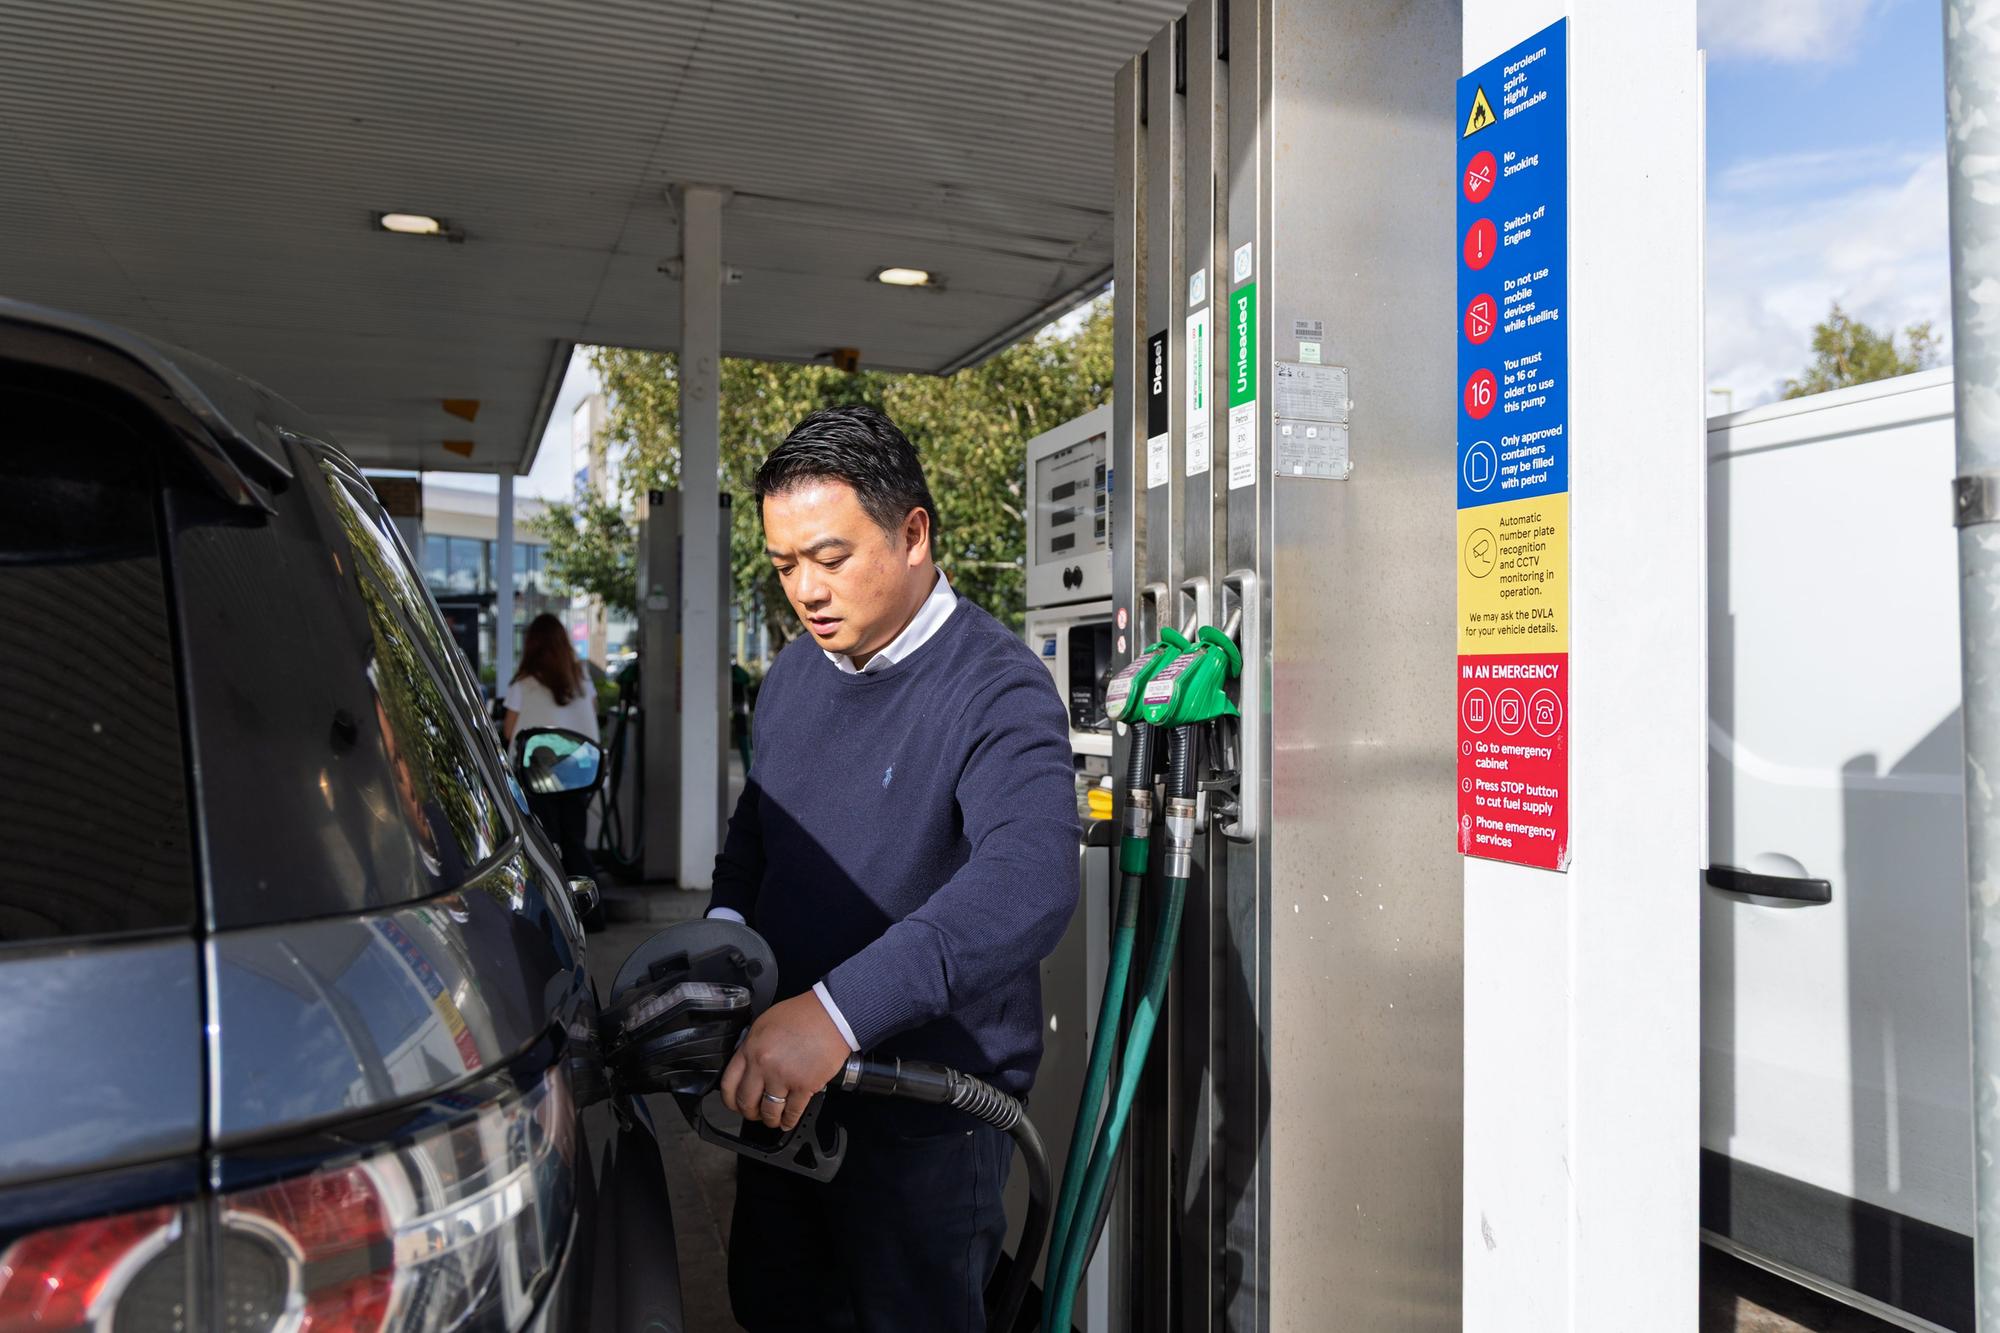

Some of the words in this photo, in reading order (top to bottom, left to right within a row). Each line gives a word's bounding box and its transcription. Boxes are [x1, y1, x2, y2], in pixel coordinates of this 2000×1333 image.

[1503, 47, 1546, 78] Petroleum
[1503, 72, 1527, 92] spirit.
[1503, 85, 1528, 106] Highly
[1503, 90, 1547, 120] flammable
[1503, 151, 1516, 163] No
[1503, 154, 1539, 177] Smoking
[1503, 212, 1531, 232] Switch
[1532, 205, 1545, 220] off
[1503, 228, 1531, 246] Engine
[1504, 280, 1516, 291] Do
[1516, 272, 1532, 286] not
[1533, 268, 1549, 280] use
[1504, 287, 1532, 305] mobile
[1503, 301, 1535, 319] devices
[1503, 318, 1526, 333] while
[1527, 308, 1559, 326] fuelling
[1237, 296, 1248, 393] Unleaded
[1153, 340, 1163, 395] Diesel
[1503, 359, 1519, 371] You
[1520, 351, 1542, 366] must
[1504, 374, 1515, 385] be
[1516, 369, 1526, 381] 16
[1526, 368, 1537, 378] or
[1471, 379, 1490, 407] 16
[1503, 386, 1526, 399] older
[1527, 383, 1537, 393] to
[1538, 378, 1554, 390] use
[1503, 400, 1520, 413] this
[1520, 395, 1546, 412] pump
[1500, 434, 1520, 447] Only
[1521, 425, 1562, 443] approved
[1501, 444, 1546, 461] containers
[1501, 464, 1518, 475] may
[1519, 461, 1531, 472] be
[1532, 455, 1554, 469] filled
[1501, 476, 1519, 489] with
[1520, 471, 1547, 488] petrol
[1499, 513, 1542, 527] Automatic
[1499, 529, 1531, 541] number
[1533, 526, 1555, 539] plate
[1499, 542, 1546, 556] recognition
[1499, 558, 1514, 570] and
[1516, 555, 1539, 568] CCTV
[1499, 570, 1544, 583] monitoring
[1546, 569, 1554, 579] in
[1499, 587, 1542, 599] operation.
[1469, 612, 1481, 622] We
[1483, 613, 1499, 623] may
[1500, 610, 1514, 621] ask
[1515, 610, 1529, 620] the
[1531, 607, 1554, 619] DVLA
[1465, 626, 1477, 636] for
[1477, 627, 1495, 638] your
[1497, 624, 1526, 635] vehicle
[1527, 622, 1558, 634] details.
[1462, 665, 1473, 678] IN
[1474, 665, 1489, 678] AN
[1492, 664, 1559, 678] EMERGENCY
[1475, 740, 1489, 753] Go
[1489, 742, 1500, 753] to
[1500, 745, 1552, 760] emergency
[1475, 757, 1508, 770] cabinet
[1475, 778, 1499, 792] Press
[1500, 780, 1525, 794] STOP
[1526, 783, 1558, 798] button
[1475, 794, 1485, 806] to
[1486, 796, 1501, 808] cut
[1502, 796, 1520, 810] fuel
[1522, 801, 1553, 816] supply
[1476, 815, 1504, 830] Phone
[1504, 822, 1556, 840] emergency
[1475, 833, 1512, 848] services
